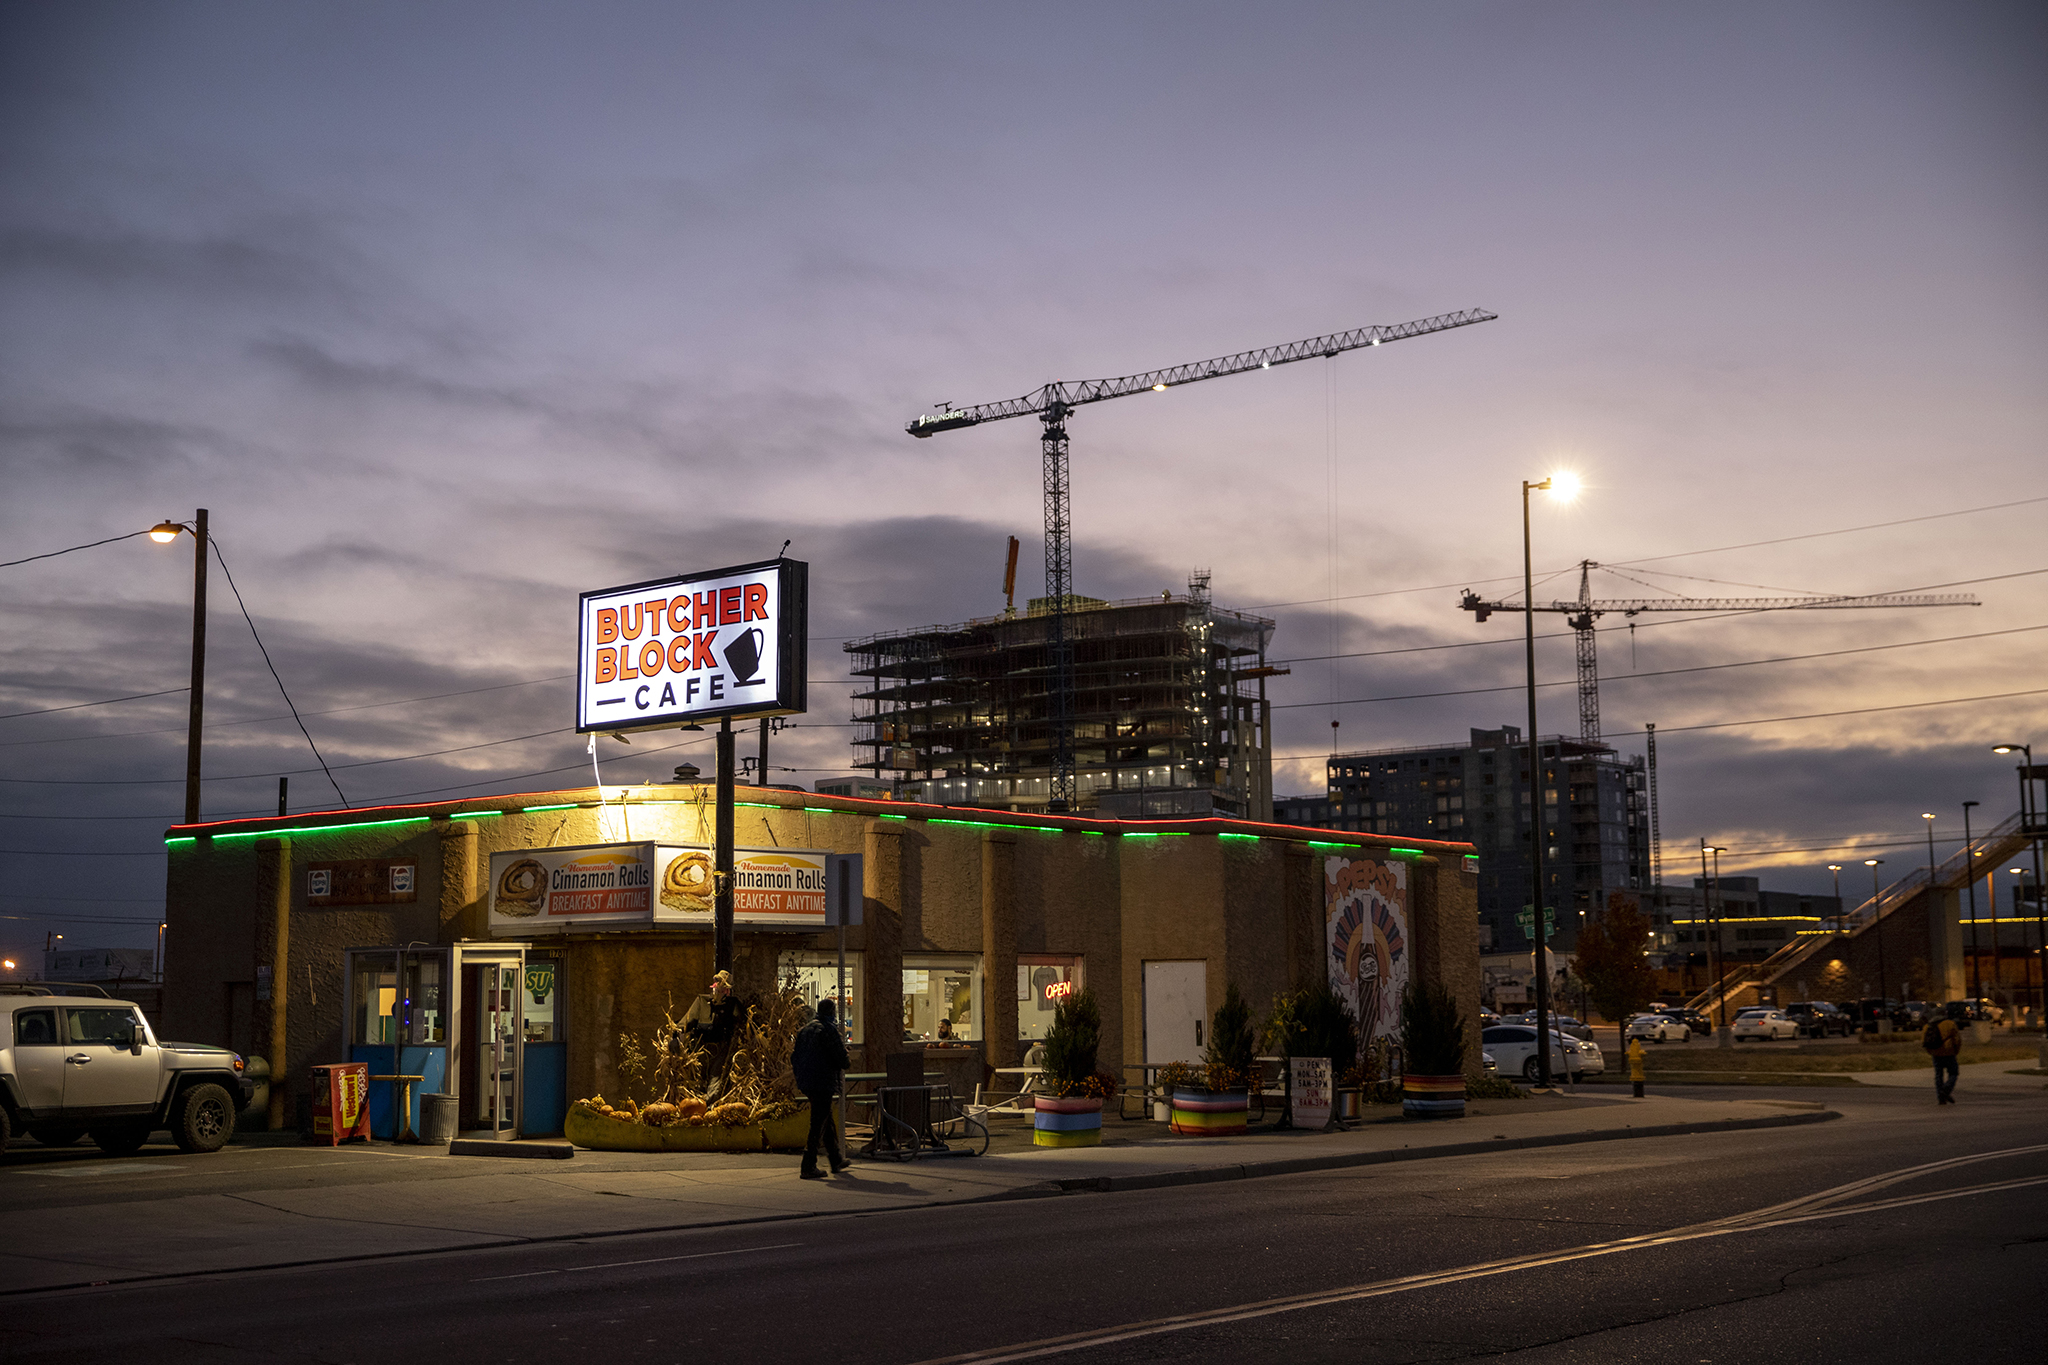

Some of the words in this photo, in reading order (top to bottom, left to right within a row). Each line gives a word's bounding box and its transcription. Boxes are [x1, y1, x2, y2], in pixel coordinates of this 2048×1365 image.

[926, 410, 964, 424] SAUNDERS
[597, 582, 769, 645] BUTCHER
[595, 630, 719, 684] BLOCK
[635, 674, 725, 710] CAFE
[552, 869, 615, 890] Cinnamon
[619, 864, 649, 886] Rolls
[567, 862, 615, 873] Homemade
[741, 862, 791, 872] Homemade
[734, 866, 792, 889] innamon
[1336, 859, 1397, 904] PEPSI
[552, 893, 603, 912] BREAKFAST
[606, 891, 646, 909] ANYTIME
[734, 893, 781, 910] REAKFAST
[786, 894, 826, 911] ANYTIME
[503, 971, 551, 991] NSU
[1045, 981, 1071, 1000] OPEN
[1306, 1089, 1319, 1097] SUN
